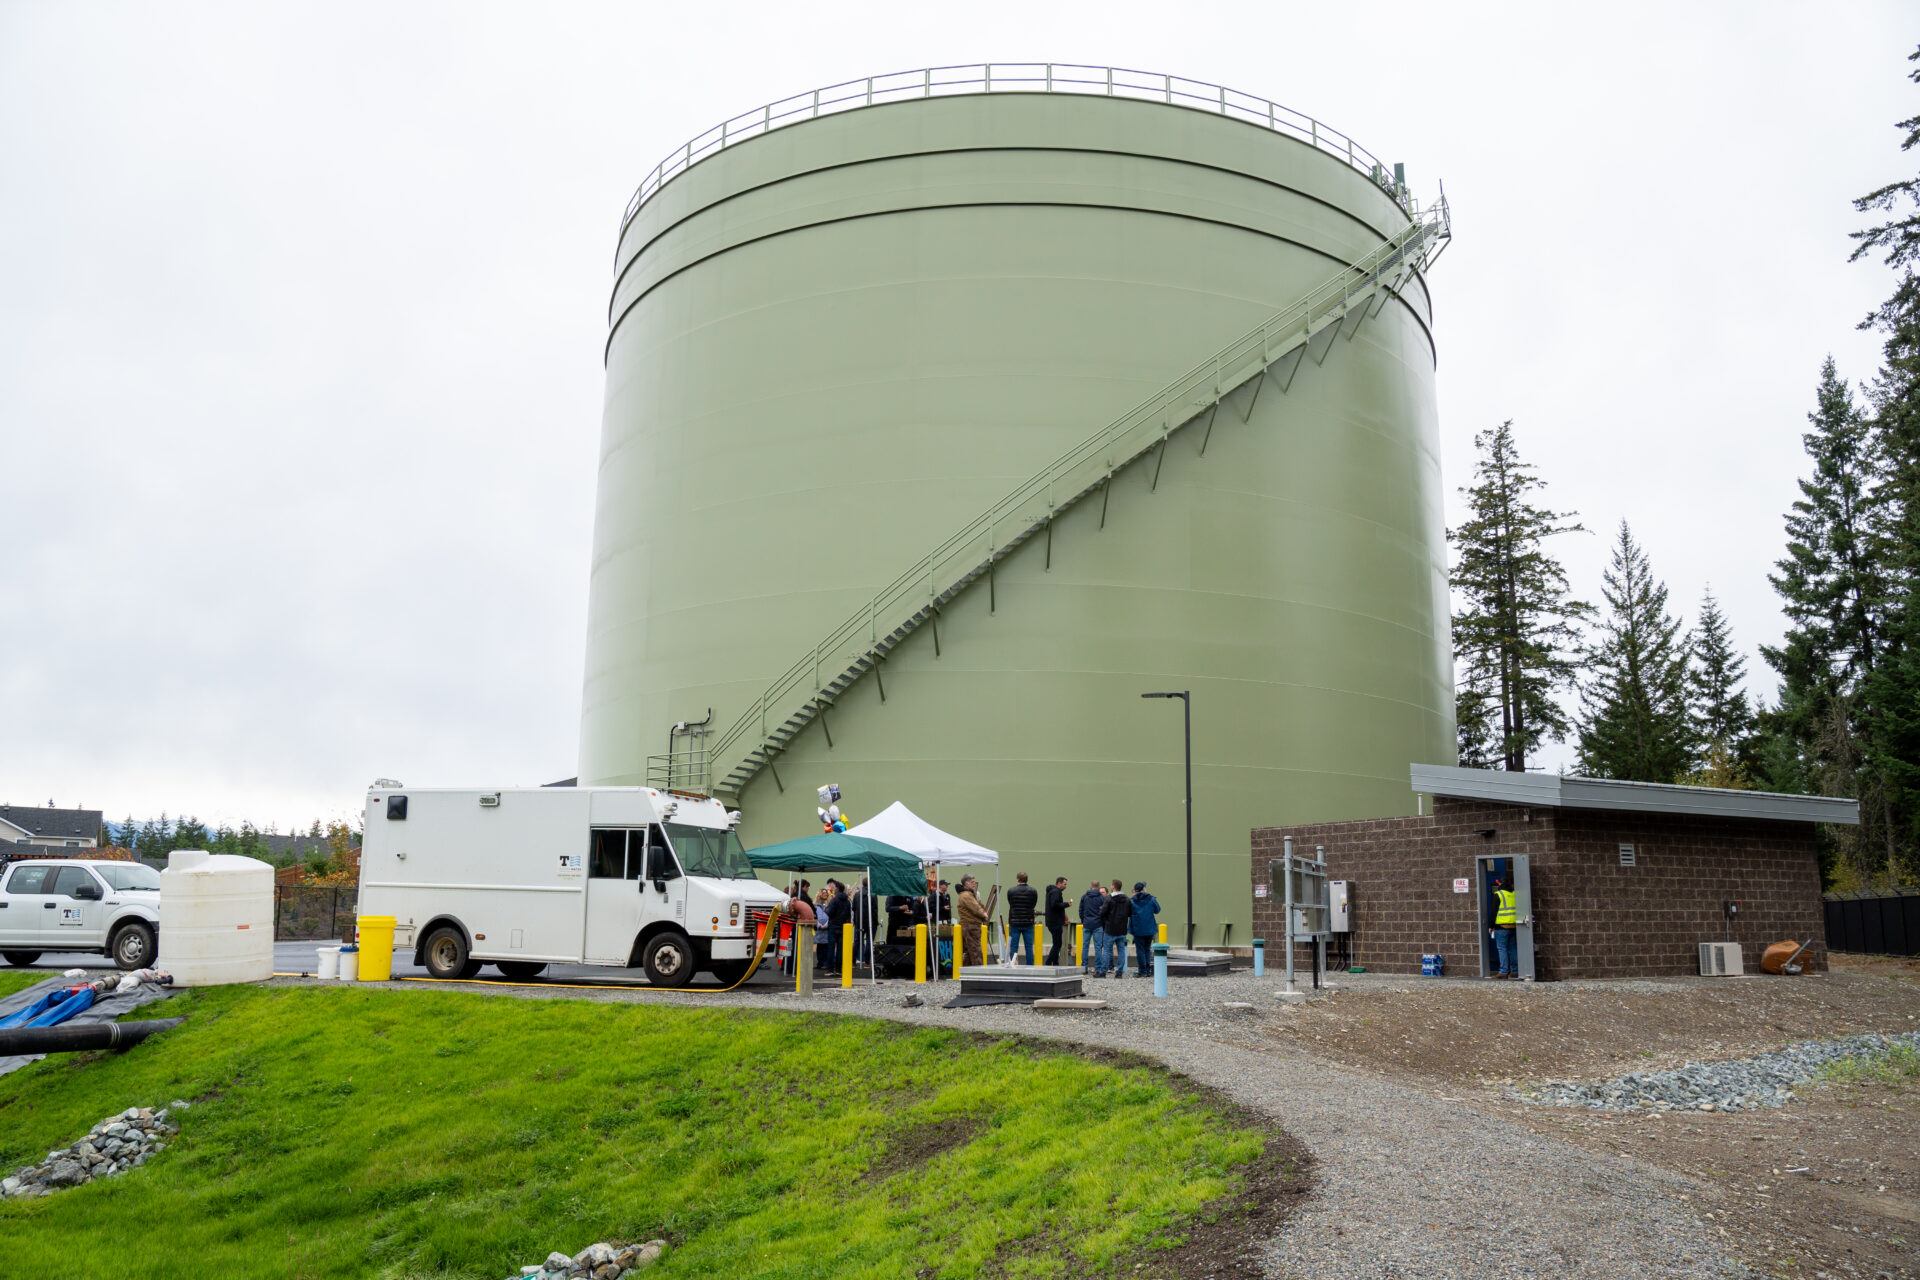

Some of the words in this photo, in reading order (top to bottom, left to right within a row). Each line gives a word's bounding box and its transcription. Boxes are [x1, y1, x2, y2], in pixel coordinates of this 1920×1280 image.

[560, 856, 569, 866] T
[64, 909, 71, 918] T
[939, 941, 953, 960] RH
